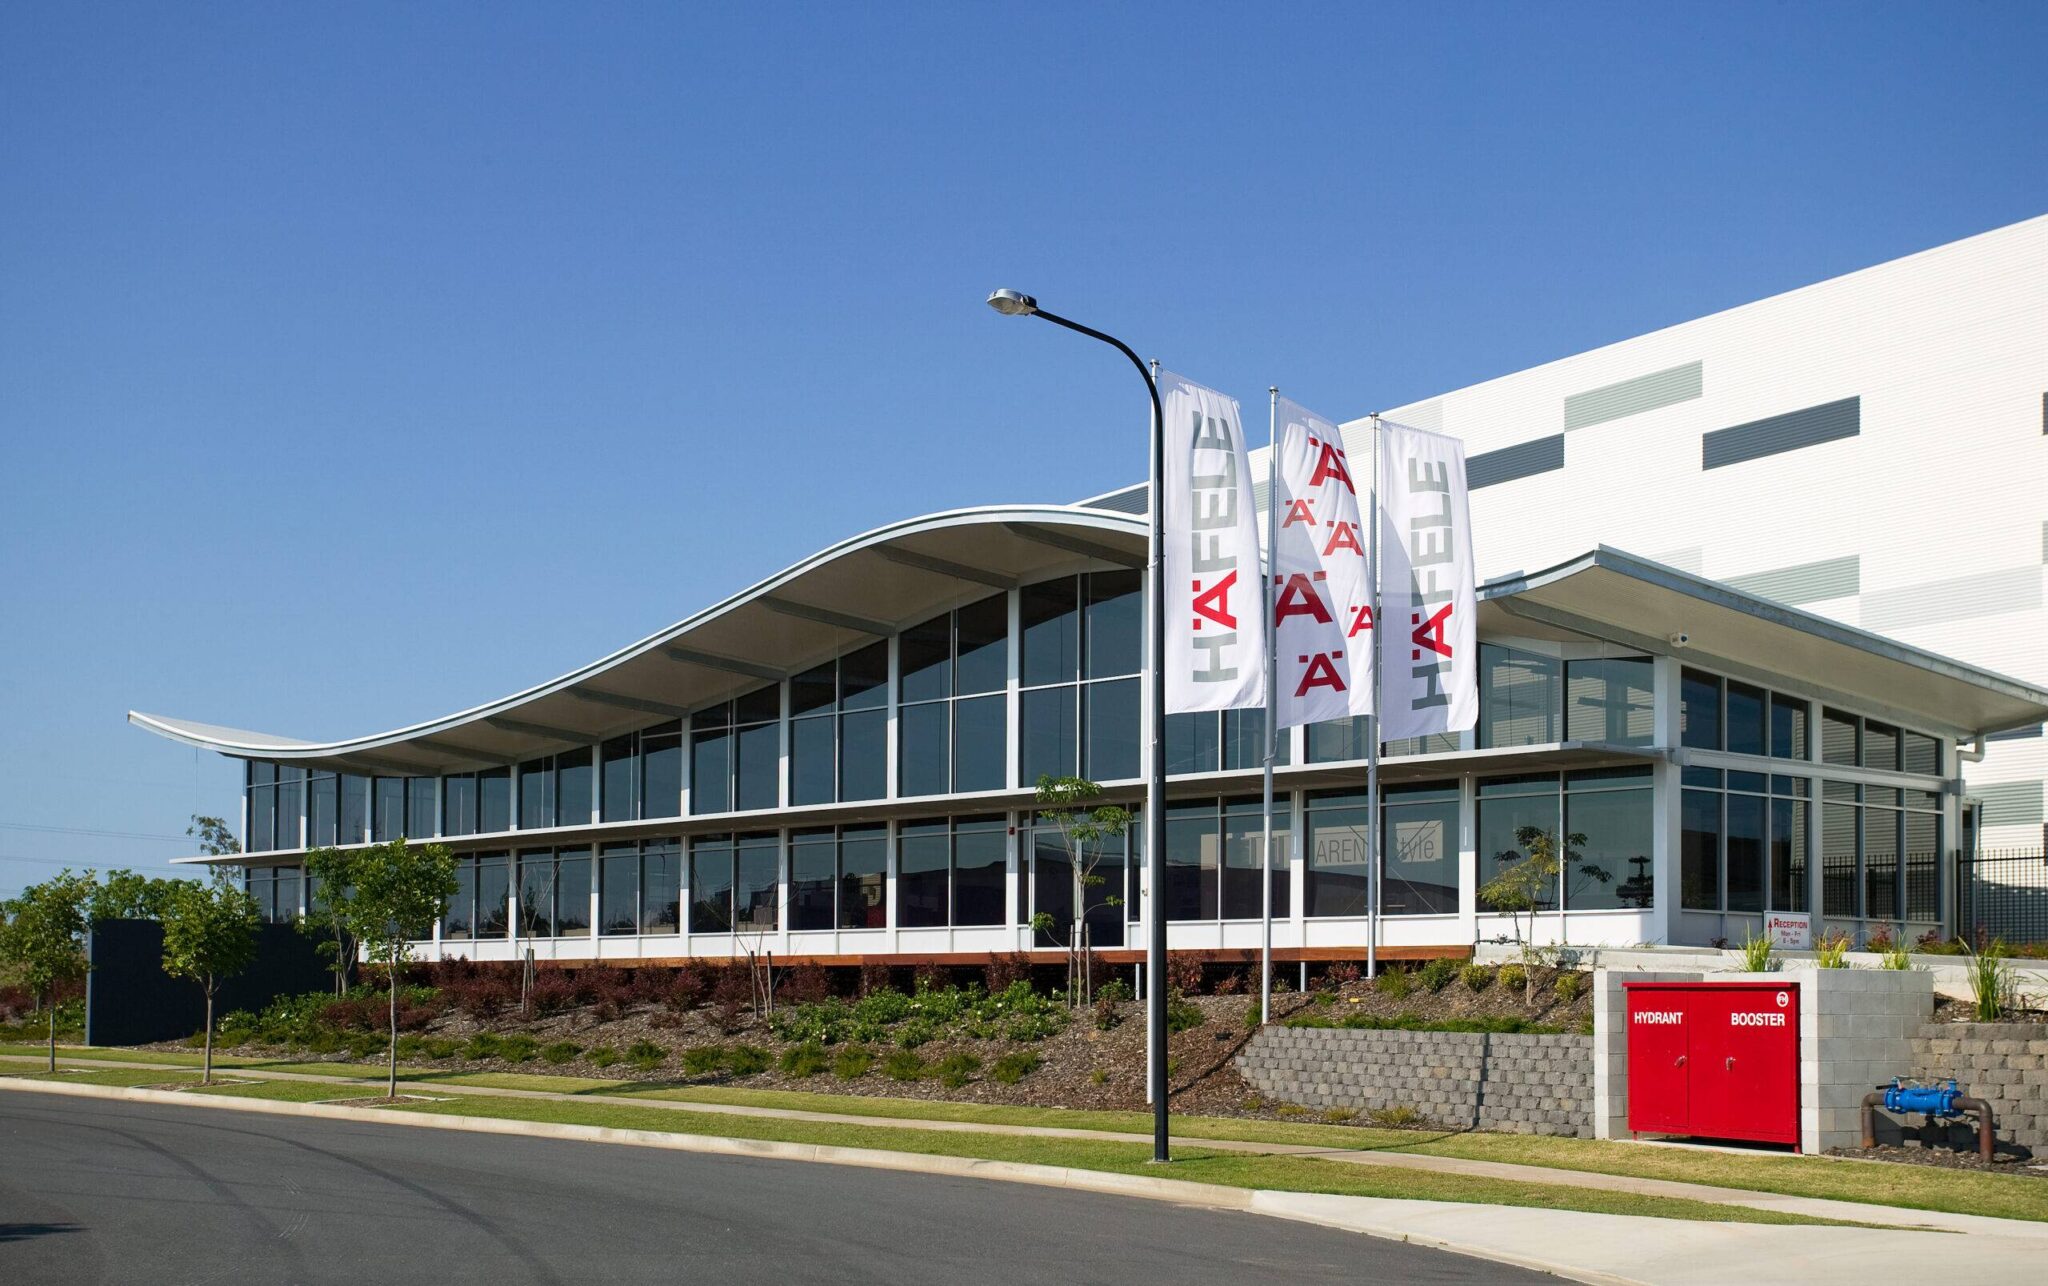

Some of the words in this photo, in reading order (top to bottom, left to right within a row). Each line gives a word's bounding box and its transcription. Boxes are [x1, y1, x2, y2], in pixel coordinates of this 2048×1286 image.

[1308, 437, 1356, 496] Ä
[1282, 498, 1317, 528] Ä
[1192, 410, 1238, 683] HÄFELE
[1322, 520, 1364, 556] Ä
[1408, 457, 1453, 711] HÄFELE
[1295, 650, 1347, 697] Ä
[1315, 838, 1372, 864] AREN
[1397, 834, 1434, 864] tyle
[1773, 917, 1808, 929] RECEPTION
[1634, 1011, 1683, 1025] HYDRANT
[1731, 1012, 1786, 1026] BOOSTER
